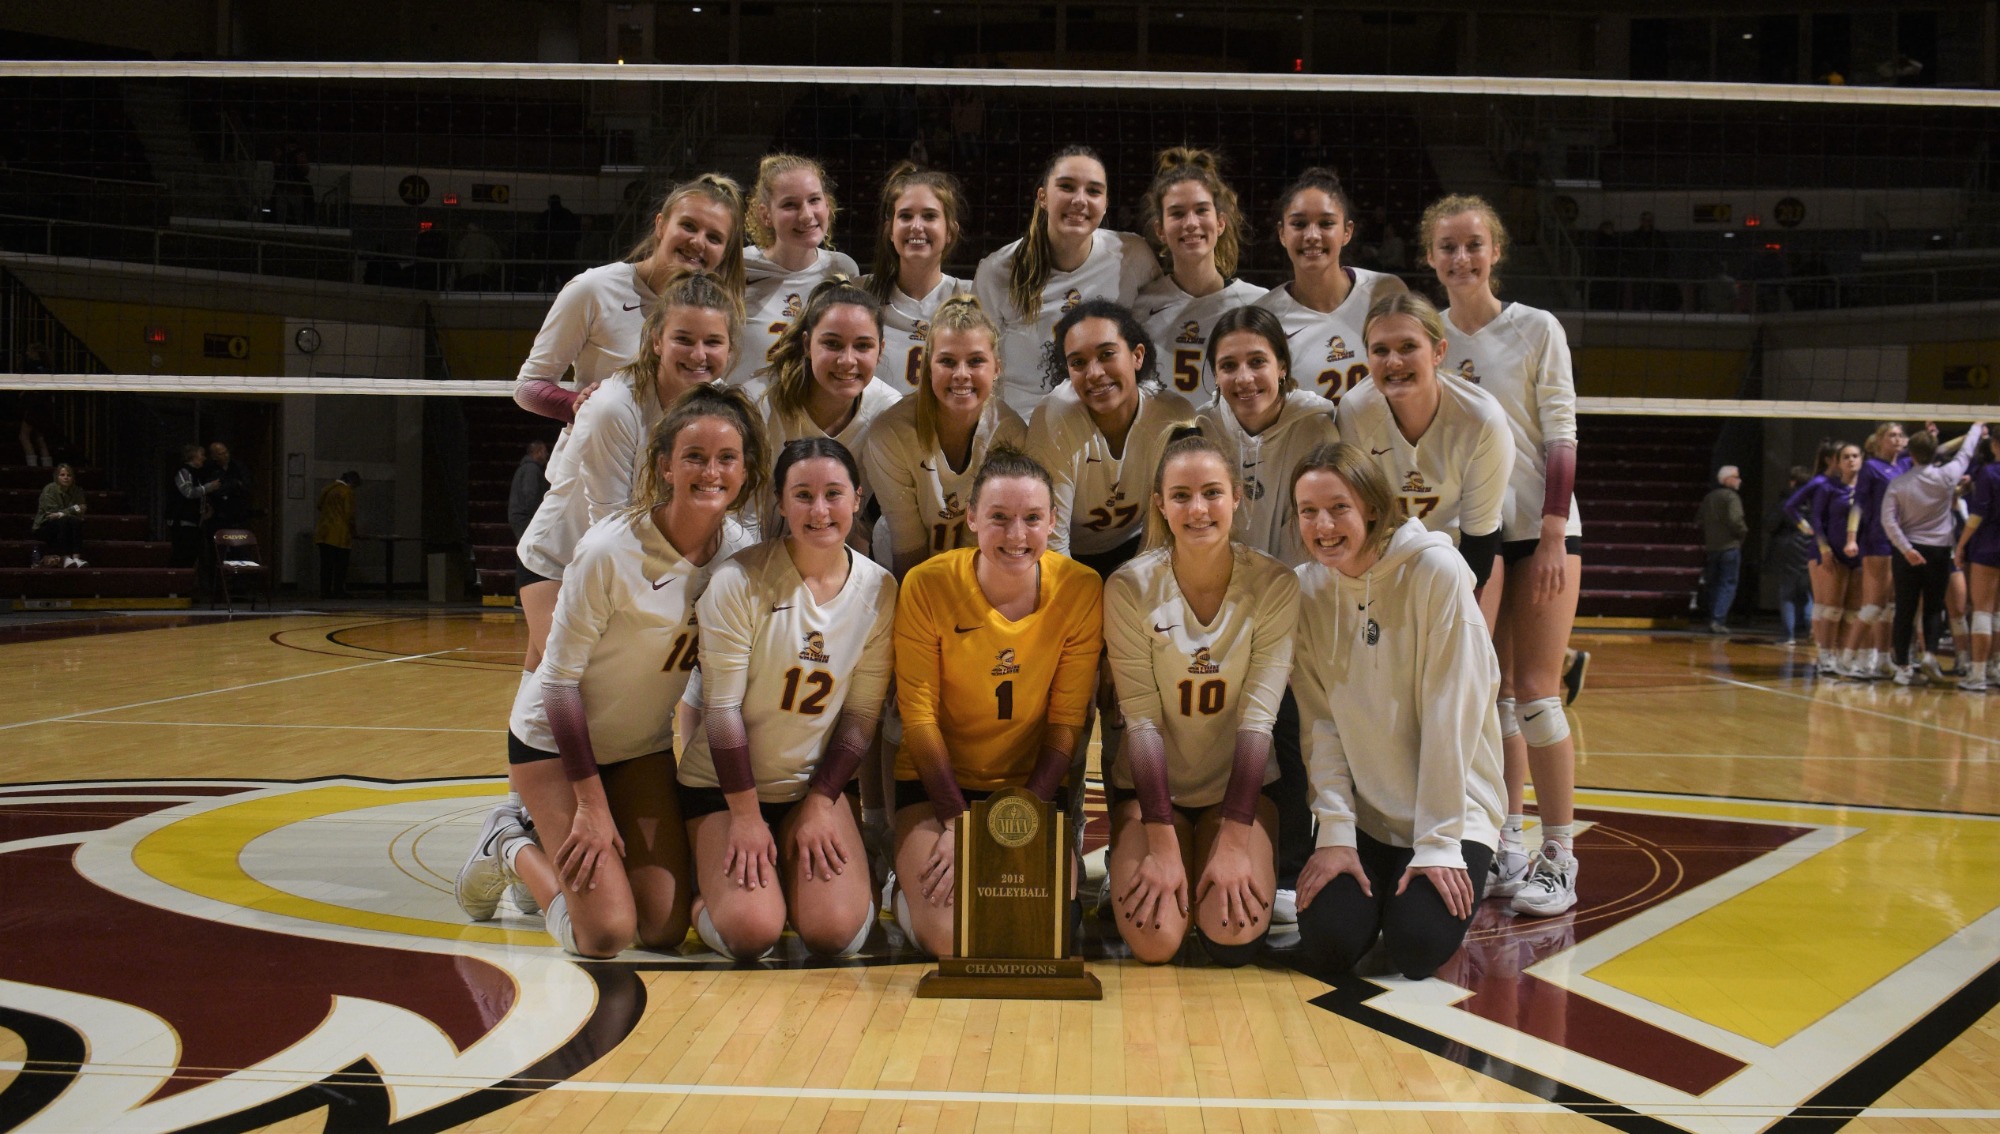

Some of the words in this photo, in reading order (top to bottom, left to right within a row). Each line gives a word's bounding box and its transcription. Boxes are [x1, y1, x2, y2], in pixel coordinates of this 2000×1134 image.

[1174, 349, 1202, 393] 5
[1082, 502, 1139, 532] 27
[1396, 495, 1440, 519] 17
[780, 665, 835, 716] 12
[995, 680, 1013, 720] 1
[1177, 678, 1228, 717] 10
[977, 886, 1049, 898] VOLLEYBALL
[1001, 873, 1025, 884] 2018
[964, 963, 1057, 975] CHAMPIONS
